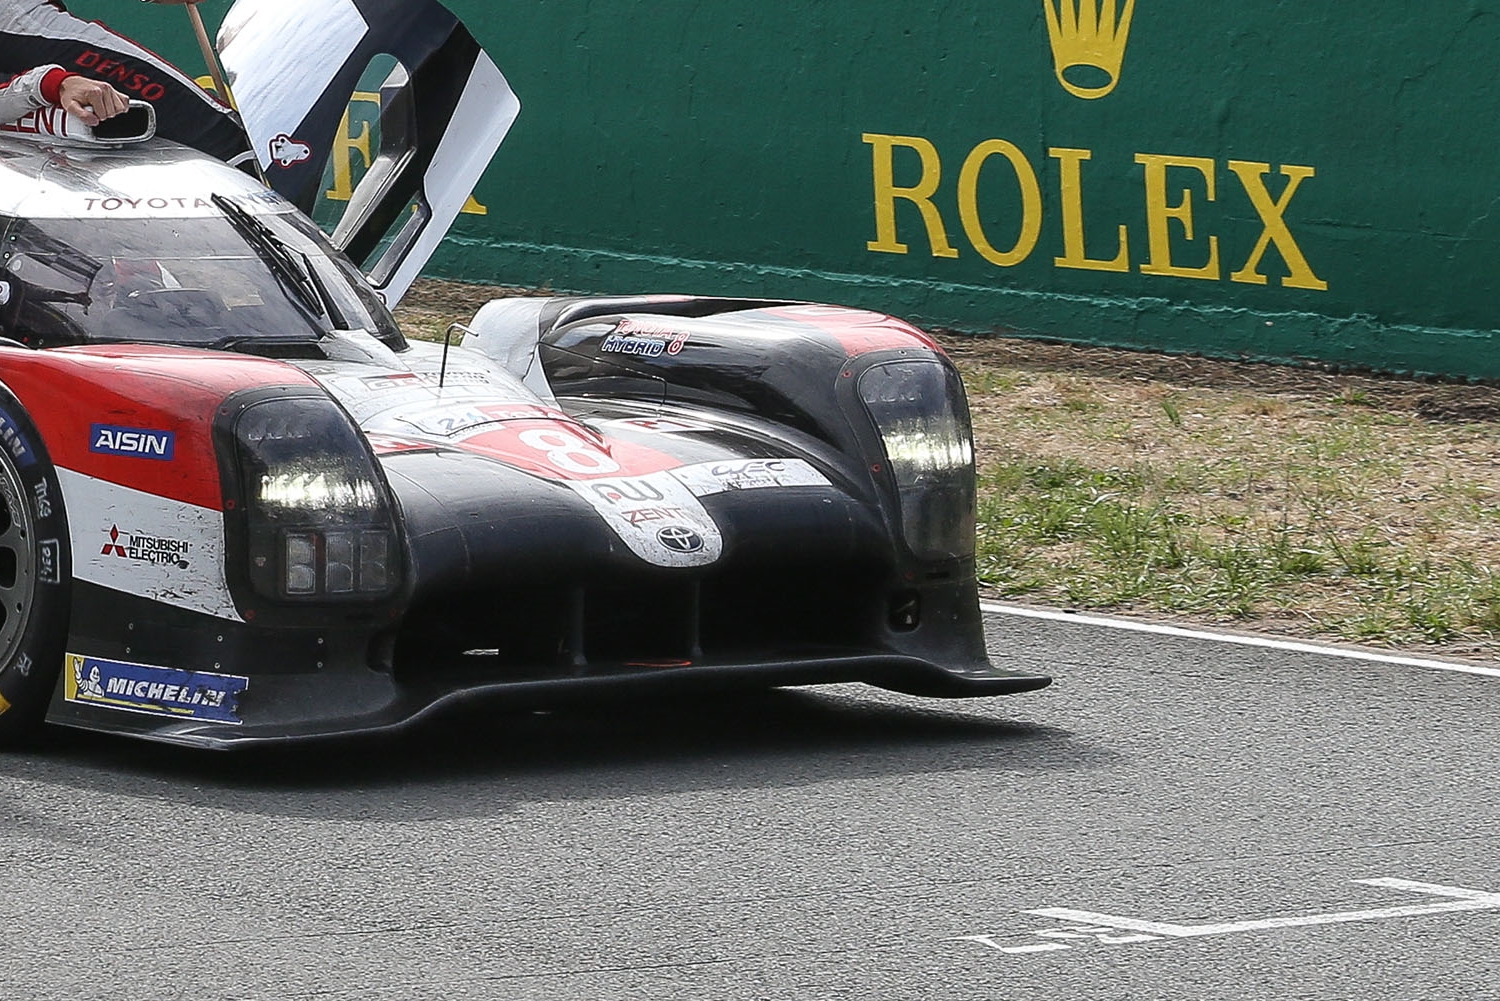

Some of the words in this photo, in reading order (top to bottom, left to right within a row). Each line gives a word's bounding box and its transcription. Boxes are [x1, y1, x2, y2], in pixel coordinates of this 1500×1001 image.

[75, 50, 167, 101] DENSO
[0, 105, 68, 138] ENT
[84, 197, 213, 210] TOYOTA
[861, 132, 1329, 291] ROLEX
[602, 335, 665, 357] HYBRID
[668, 330, 690, 355] 8
[518, 428, 621, 475] 8
[621, 507, 685, 523] ZENT
[130, 535, 189, 554] MITSUBISHI
[106, 677, 226, 708] MICHELIN
